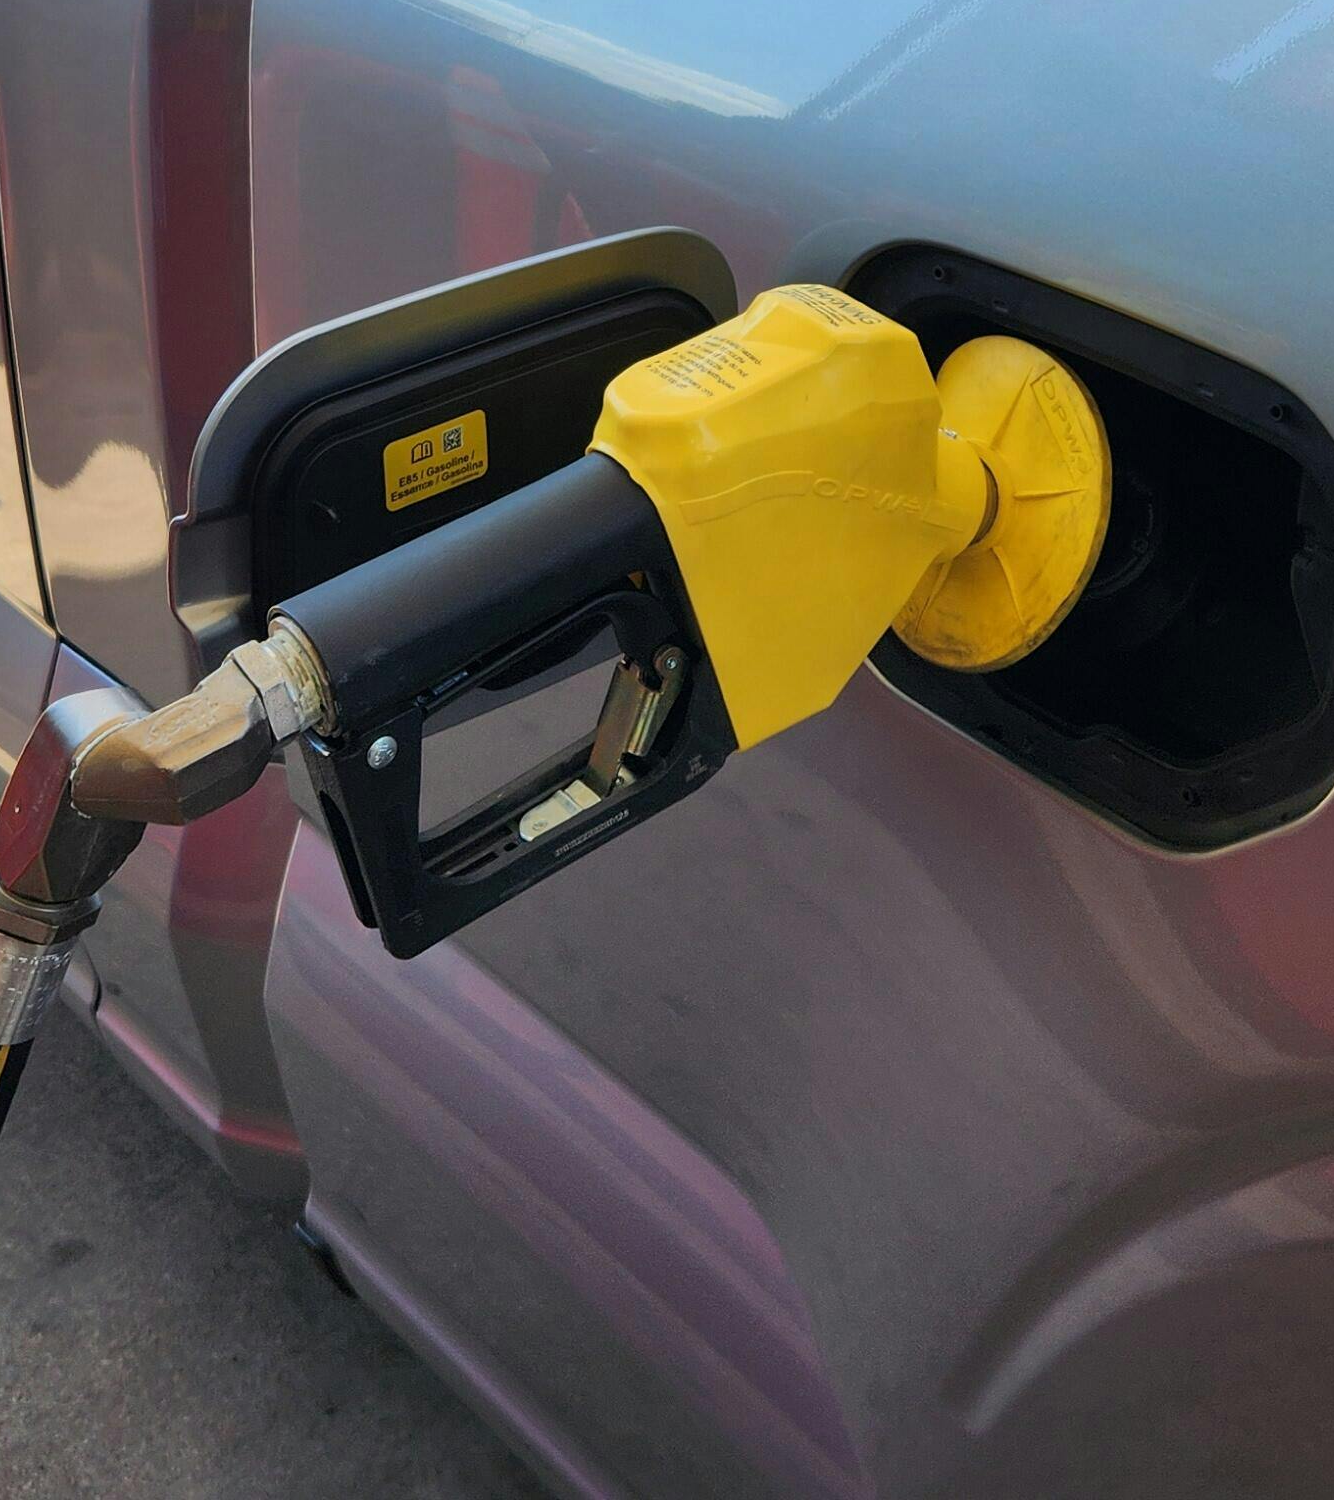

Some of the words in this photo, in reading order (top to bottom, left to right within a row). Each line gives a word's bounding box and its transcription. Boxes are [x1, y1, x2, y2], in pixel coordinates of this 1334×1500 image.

[390, 479, 434, 503] Essence
[441, 460, 484, 482] Gasolina
[398, 473, 419, 488] E85
[426, 454, 470, 478] Gasoline
